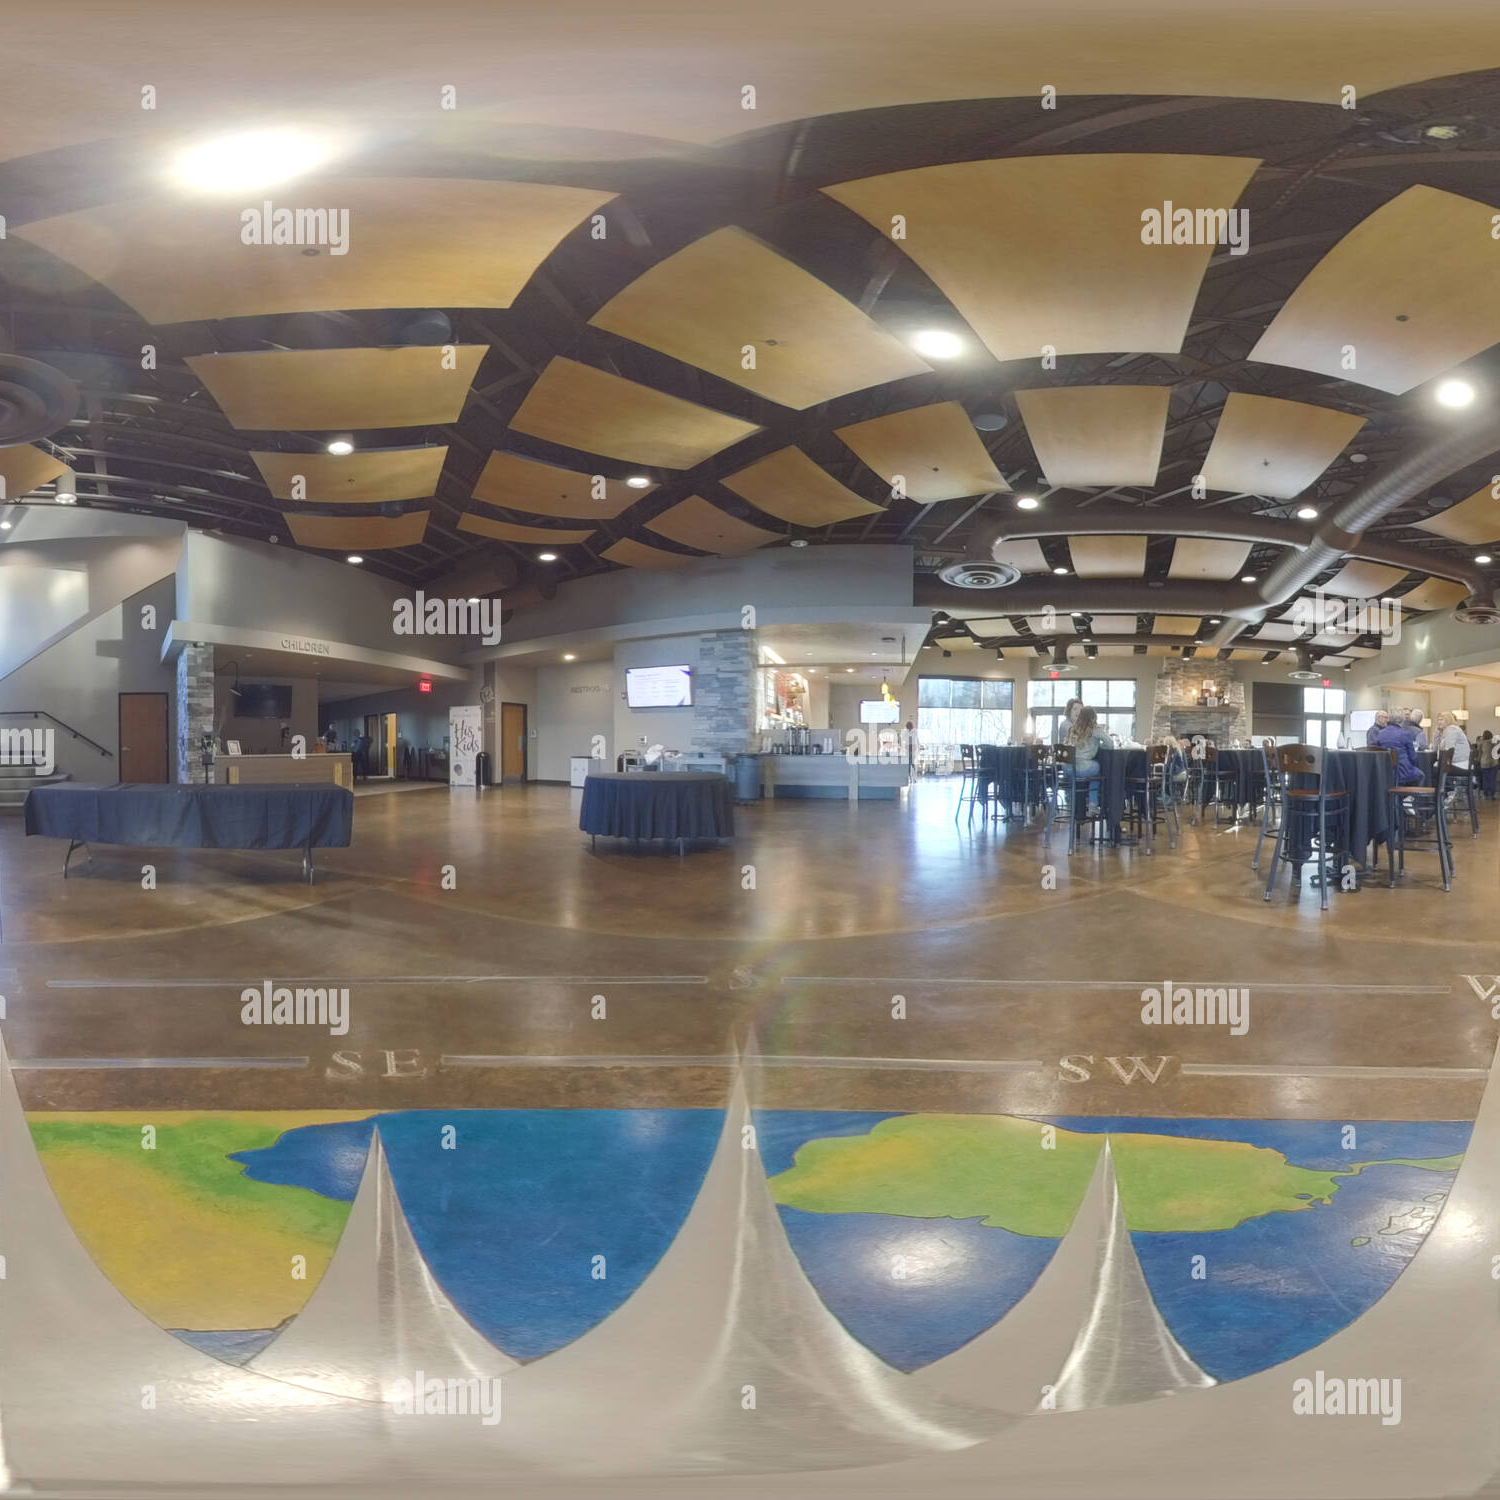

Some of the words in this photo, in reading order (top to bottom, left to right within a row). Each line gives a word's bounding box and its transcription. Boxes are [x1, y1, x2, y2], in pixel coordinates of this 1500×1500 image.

[280, 638, 330, 656] CHILDREN
[454, 720, 474, 739] His
[455, 735, 480, 757] Kids
[324, 1049, 428, 1079] SE
[1058, 1054, 1176, 1085] SW
